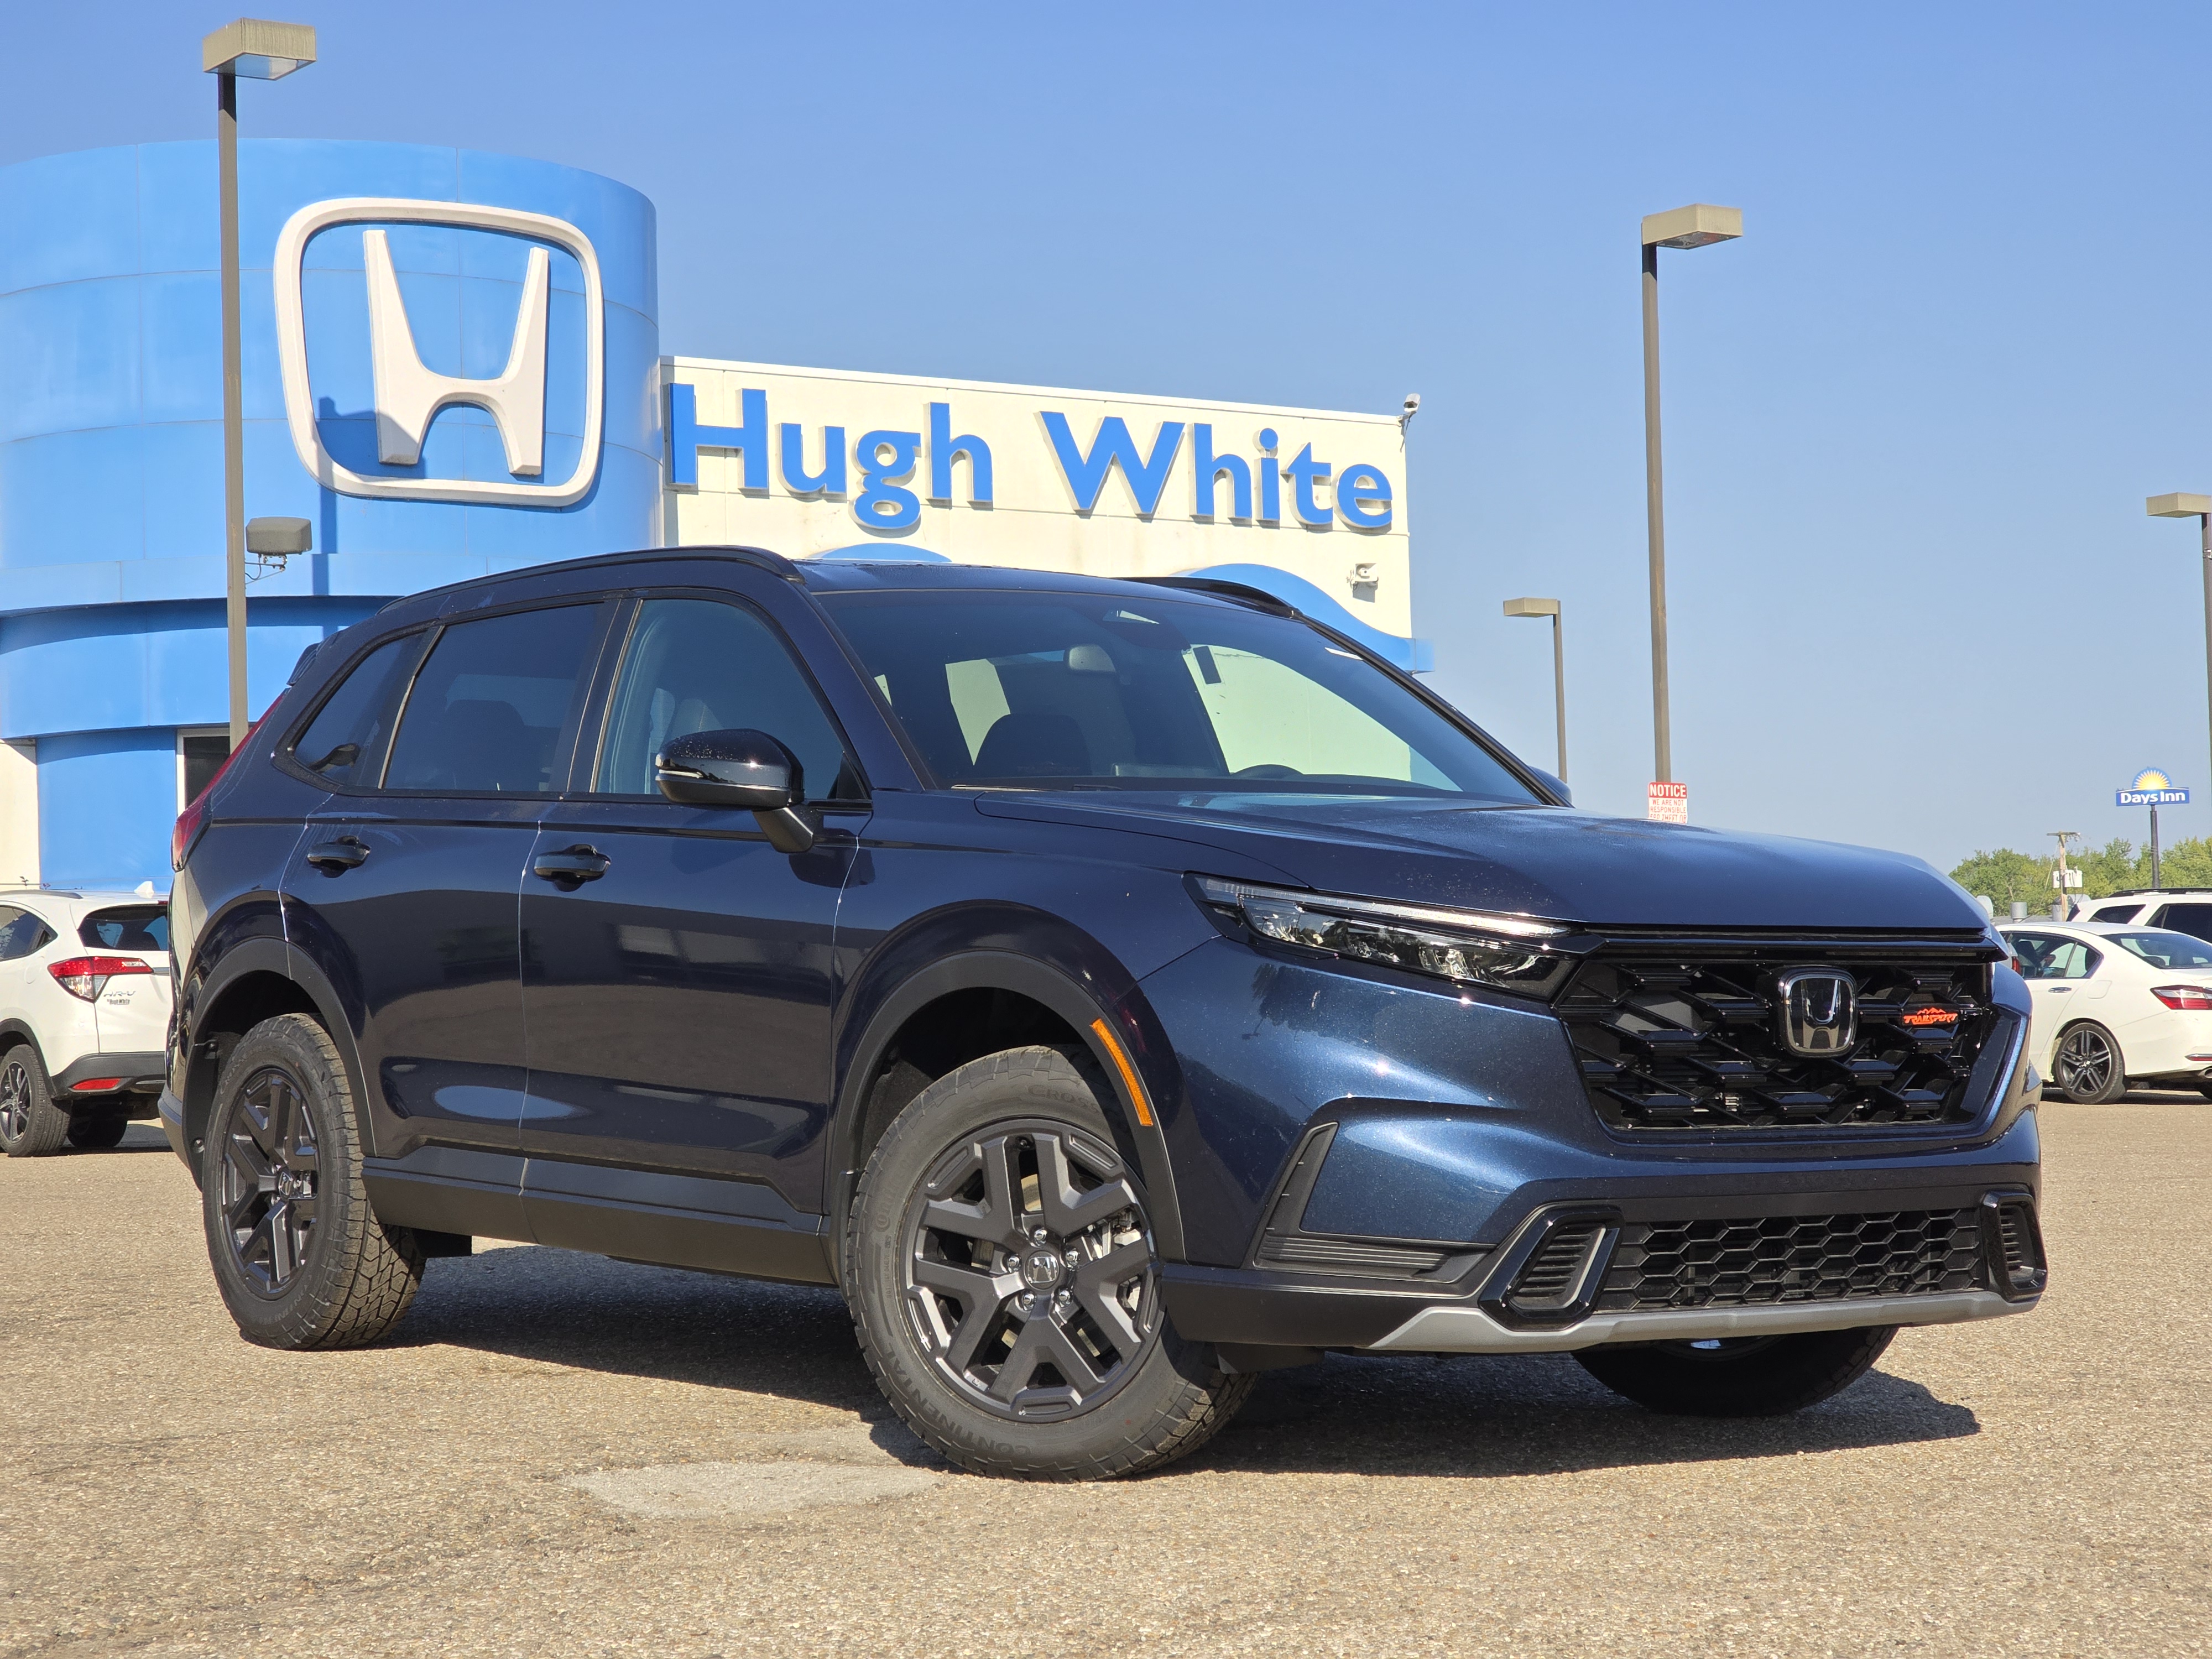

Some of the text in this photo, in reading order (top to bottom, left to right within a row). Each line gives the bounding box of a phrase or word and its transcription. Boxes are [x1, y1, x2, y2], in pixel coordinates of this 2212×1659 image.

[668, 383, 1393, 530] Hugh White
[1650, 784, 1686, 797] NOTICE
[2120, 791, 2185, 804] Days Inn
[1903, 1013, 1958, 1025] TRAILSPORT
[884, 1342, 1032, 1456] CONTINENTAL
